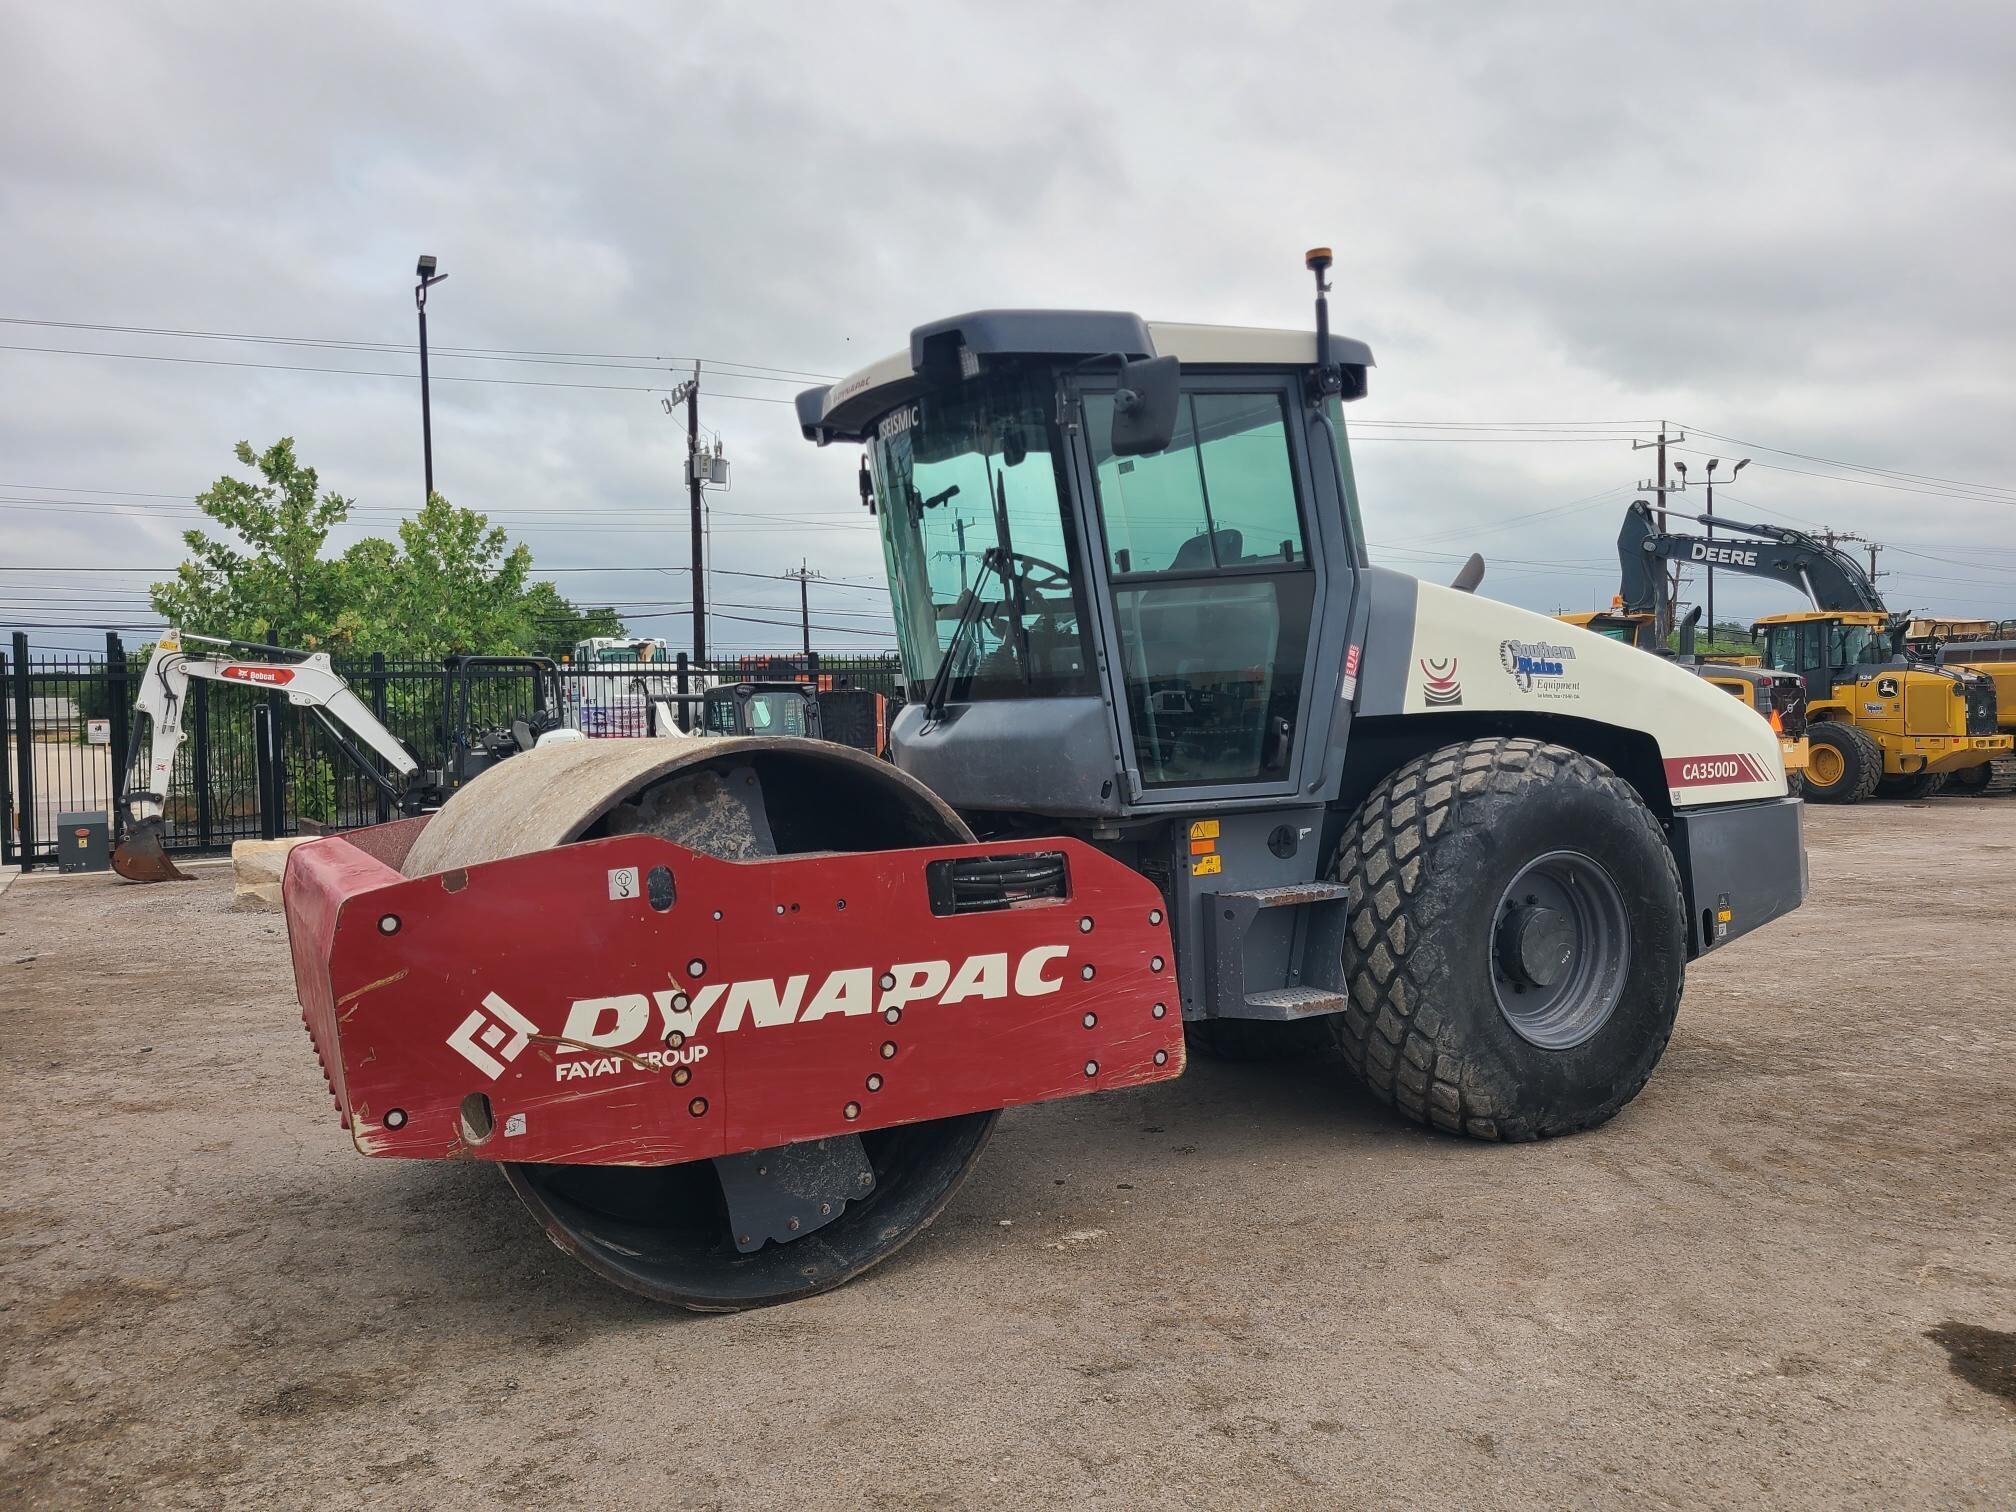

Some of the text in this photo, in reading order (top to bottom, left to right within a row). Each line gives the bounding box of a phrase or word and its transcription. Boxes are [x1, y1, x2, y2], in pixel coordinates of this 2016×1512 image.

[880, 406, 919, 440] SEISMIC
[1691, 543, 1758, 567] DEERE
[1510, 639, 1576, 659] Southern
[1517, 655, 1564, 675] Plains
[250, 671, 276, 681] Bobcat
[1537, 679, 1580, 692] Equipment
[1682, 761, 1738, 780] CA3500D
[556, 945, 1070, 1054] DYNAPAC
[556, 1045, 709, 1082] FAYAT GROUP
